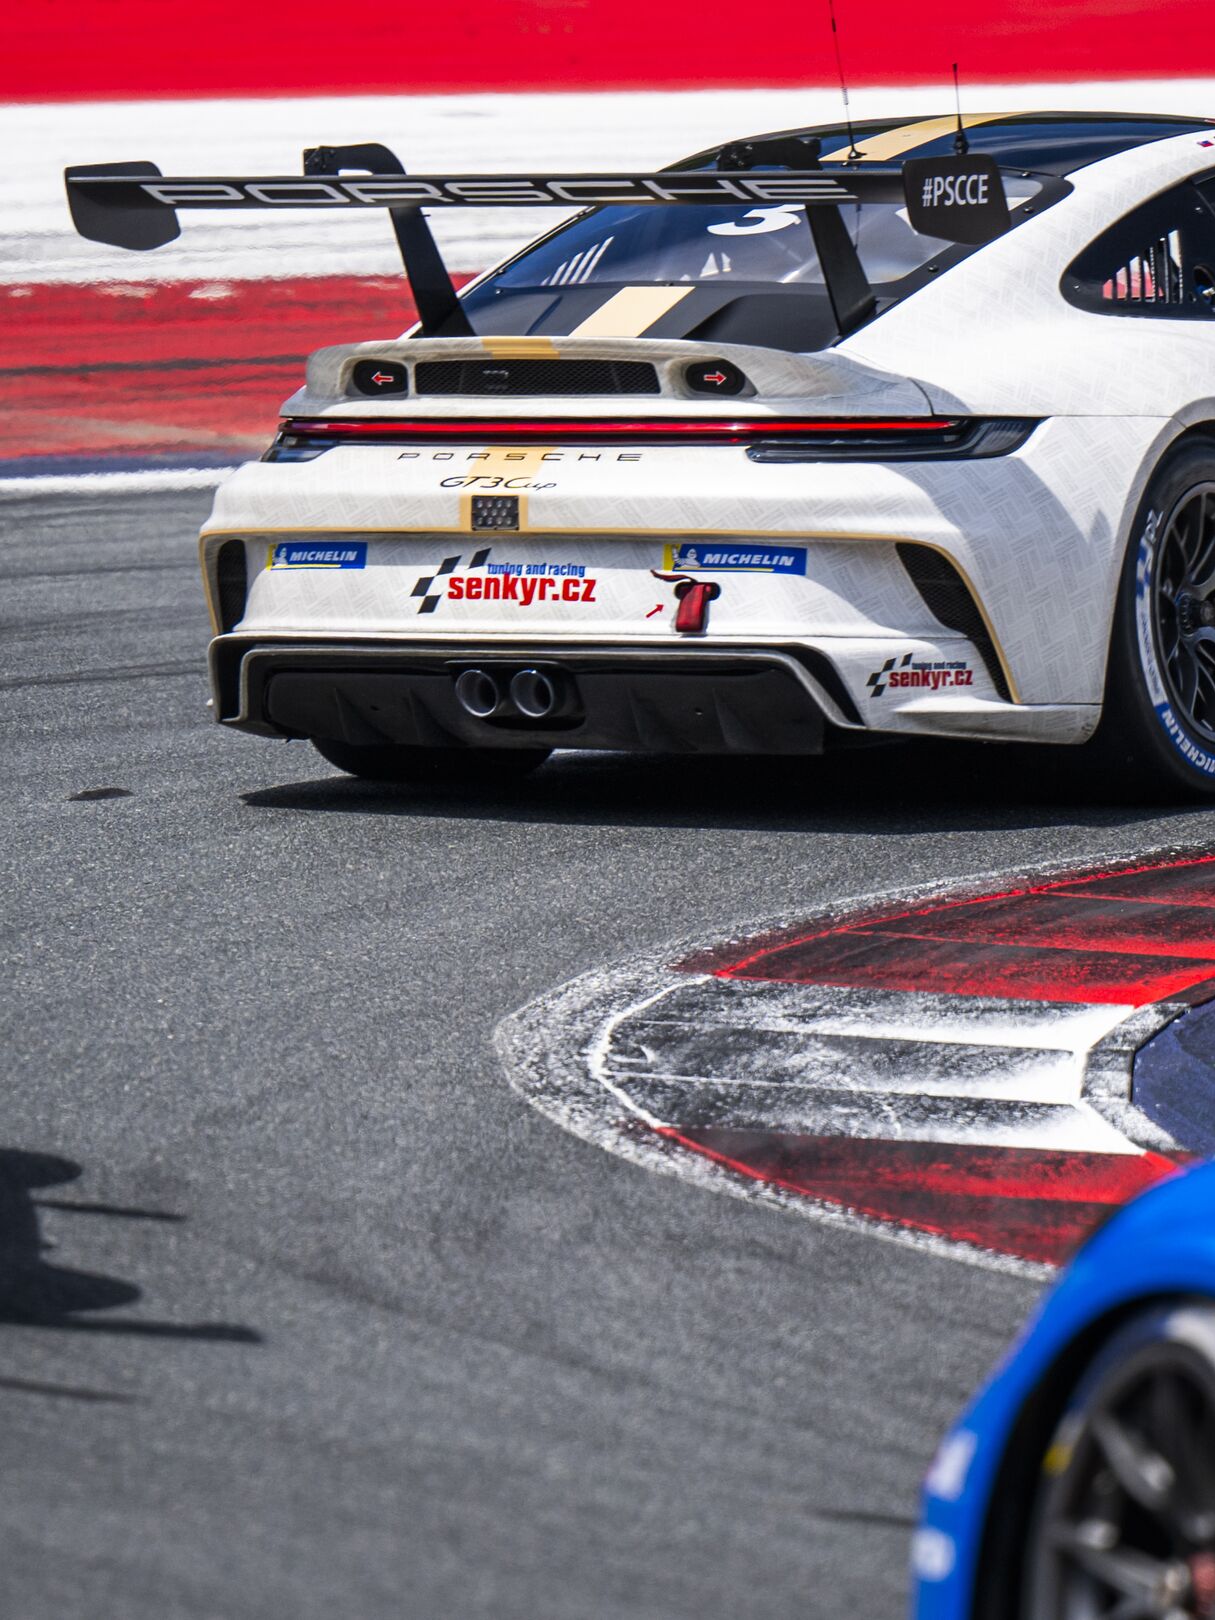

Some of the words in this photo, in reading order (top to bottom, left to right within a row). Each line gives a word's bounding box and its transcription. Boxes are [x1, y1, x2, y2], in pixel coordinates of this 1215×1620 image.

[140, 178, 860, 204] PORSCHE
[921, 174, 990, 208] #PSCCE
[397, 452, 643, 462] PORSCHE
[290, 550, 358, 562] MICHELIN
[703, 553, 795, 567] MICHELIN
[487, 562, 522, 577] tuning
[526, 562, 547, 576] and
[548, 563, 586, 578] racing
[447, 571, 597, 607] senkyr.cz
[889, 669, 973, 690] senkyr.cz
